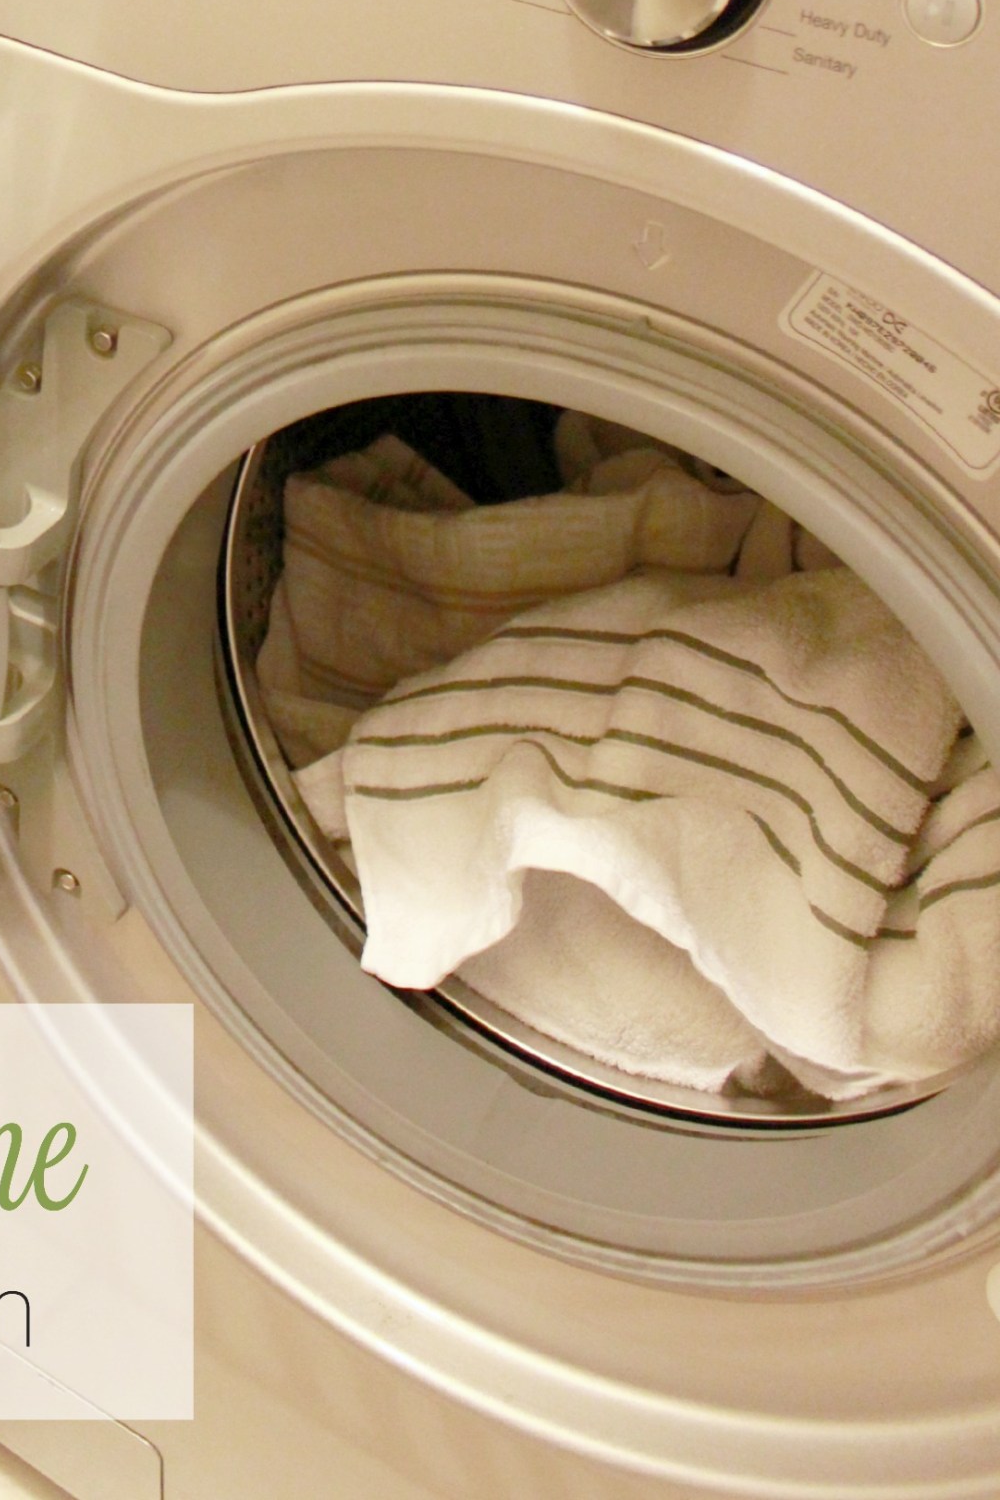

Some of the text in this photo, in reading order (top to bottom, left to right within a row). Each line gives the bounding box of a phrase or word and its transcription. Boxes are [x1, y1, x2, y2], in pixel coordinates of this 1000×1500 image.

[800, 8, 892, 48] Heavy Duty
[792, 46, 858, 80] Sanitary
